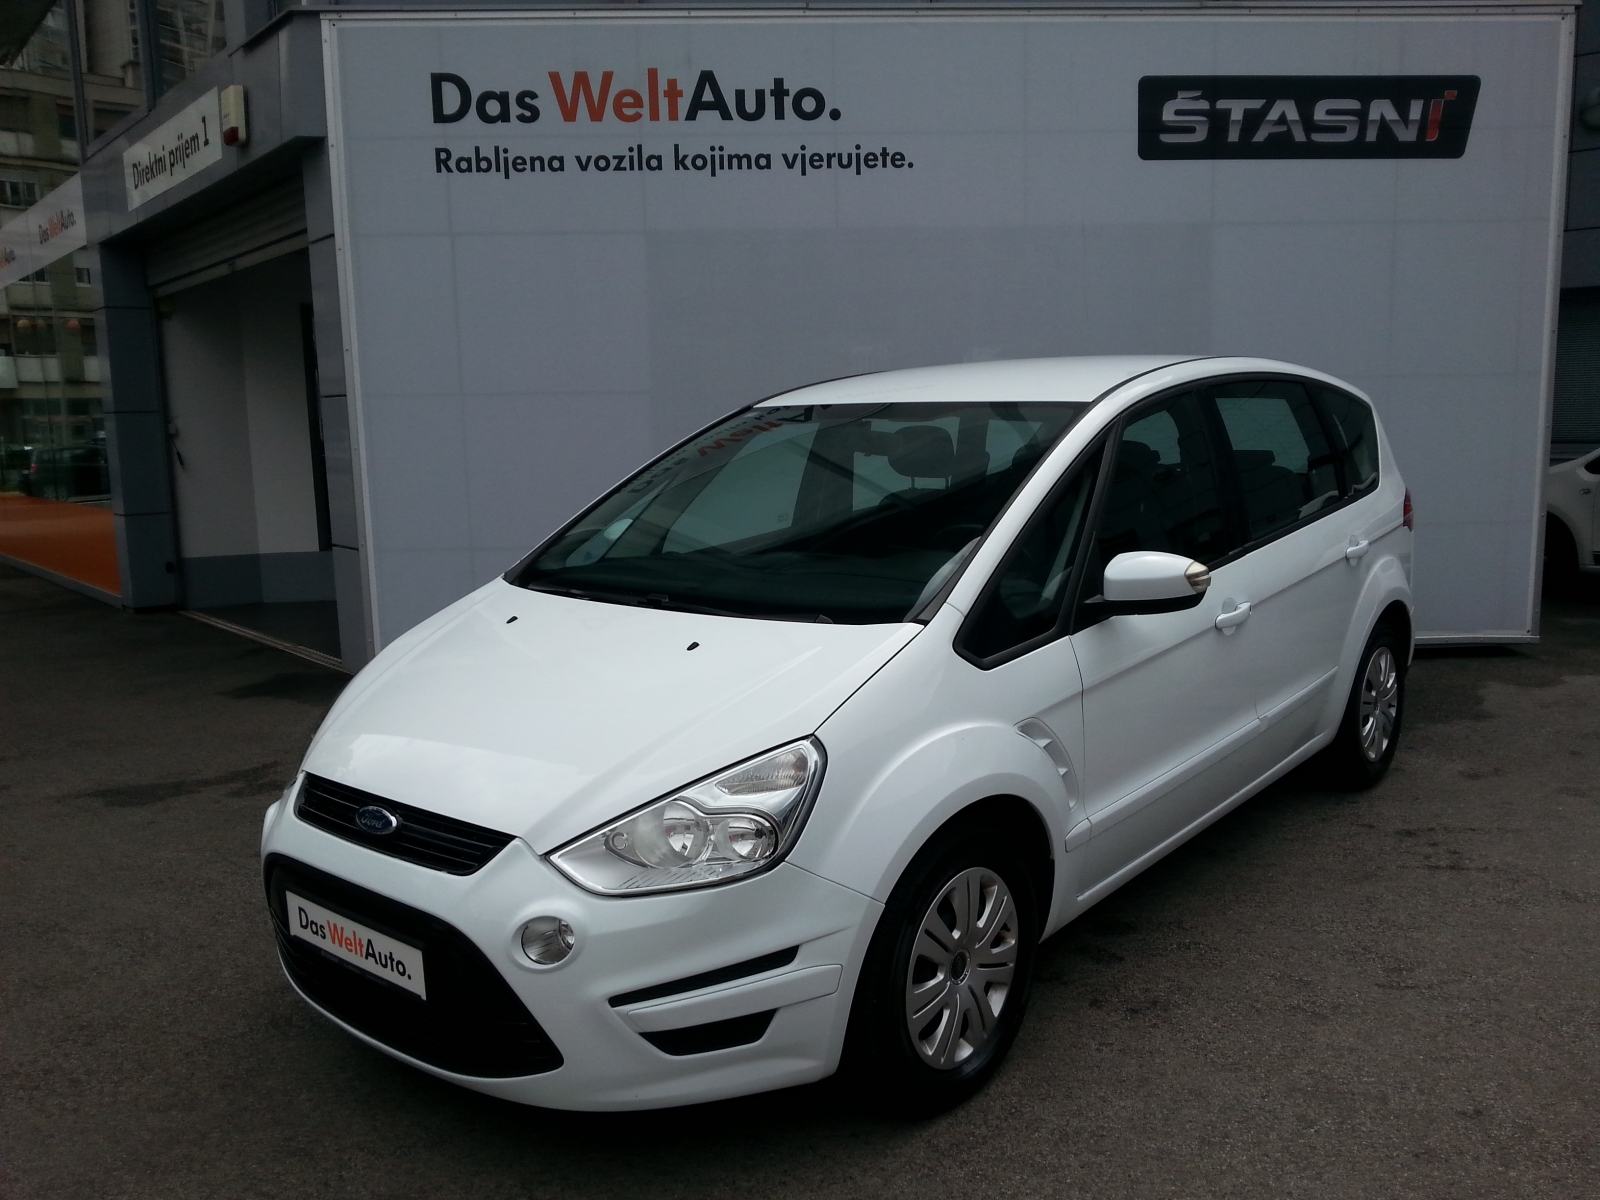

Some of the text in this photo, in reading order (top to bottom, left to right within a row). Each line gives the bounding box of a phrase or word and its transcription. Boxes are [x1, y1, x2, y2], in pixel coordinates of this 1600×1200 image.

[429, 71, 541, 124] Das
[132, 115, 210, 190] Direktni prijem 1
[434, 143, 915, 180] Rabljena vozila kojima vjerujete.
[298, 906, 326, 940] Das
